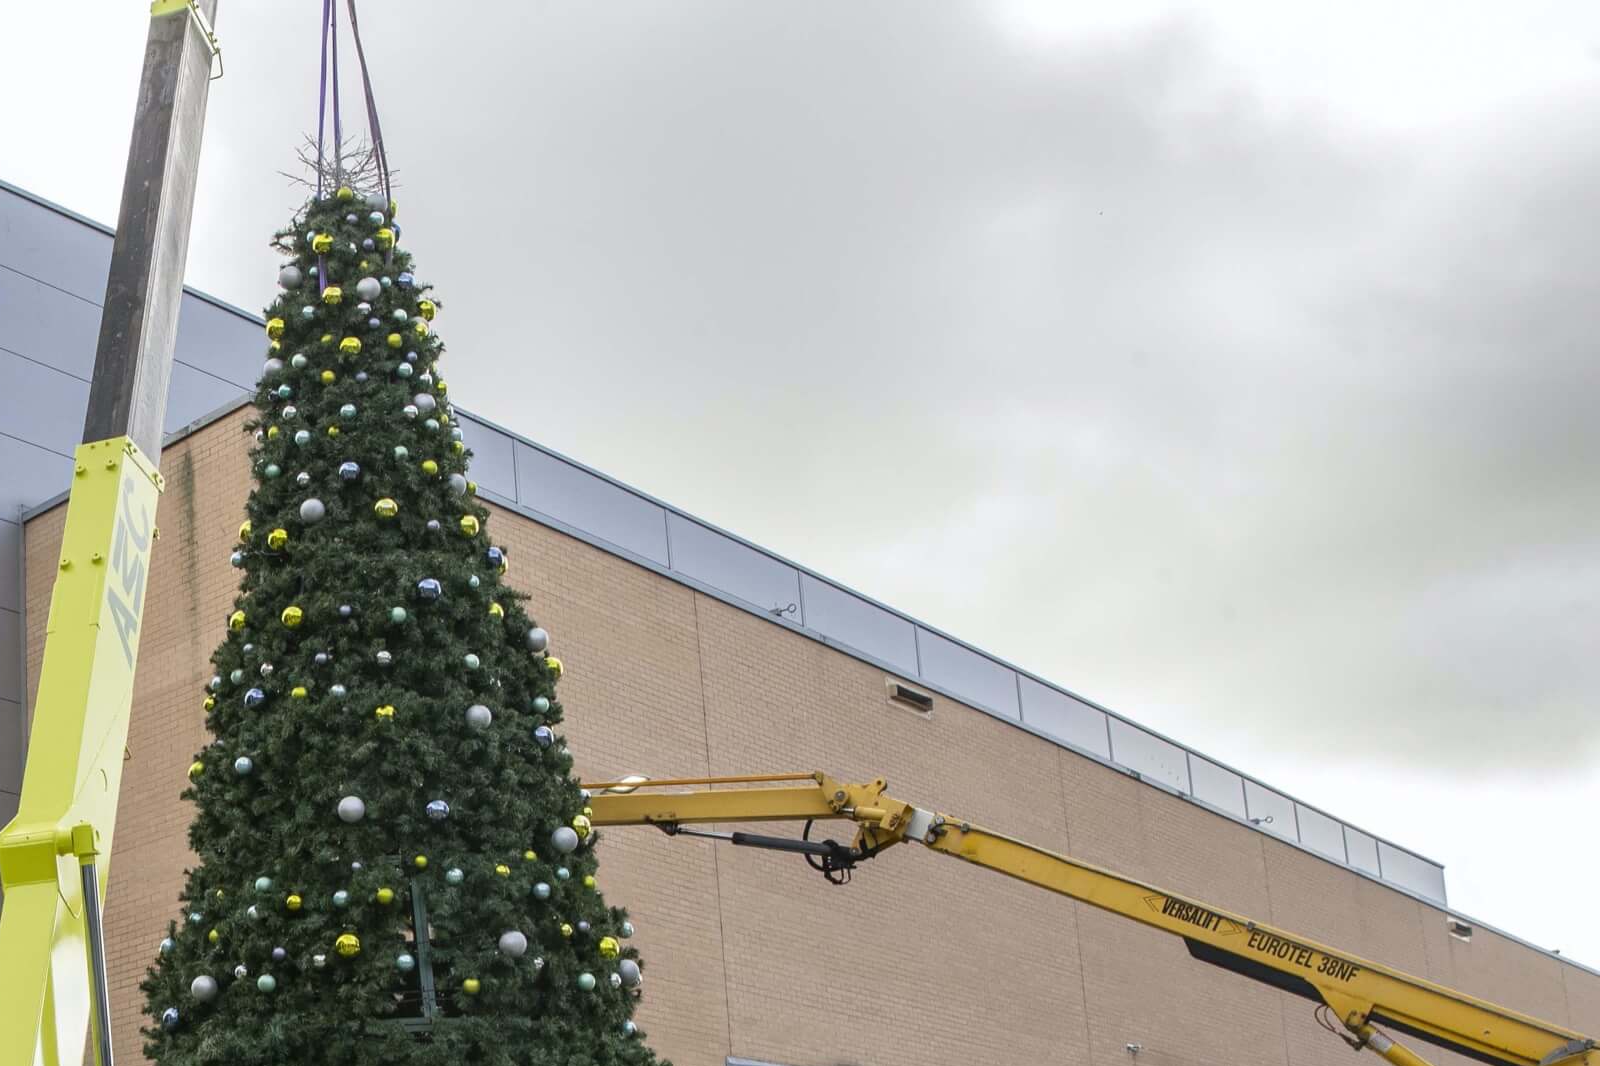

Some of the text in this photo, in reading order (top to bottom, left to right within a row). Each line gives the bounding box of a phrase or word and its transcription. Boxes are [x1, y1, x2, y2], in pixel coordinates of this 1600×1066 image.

[1161, 897, 1361, 983] VERSALIFT EUROTEL 38NF
